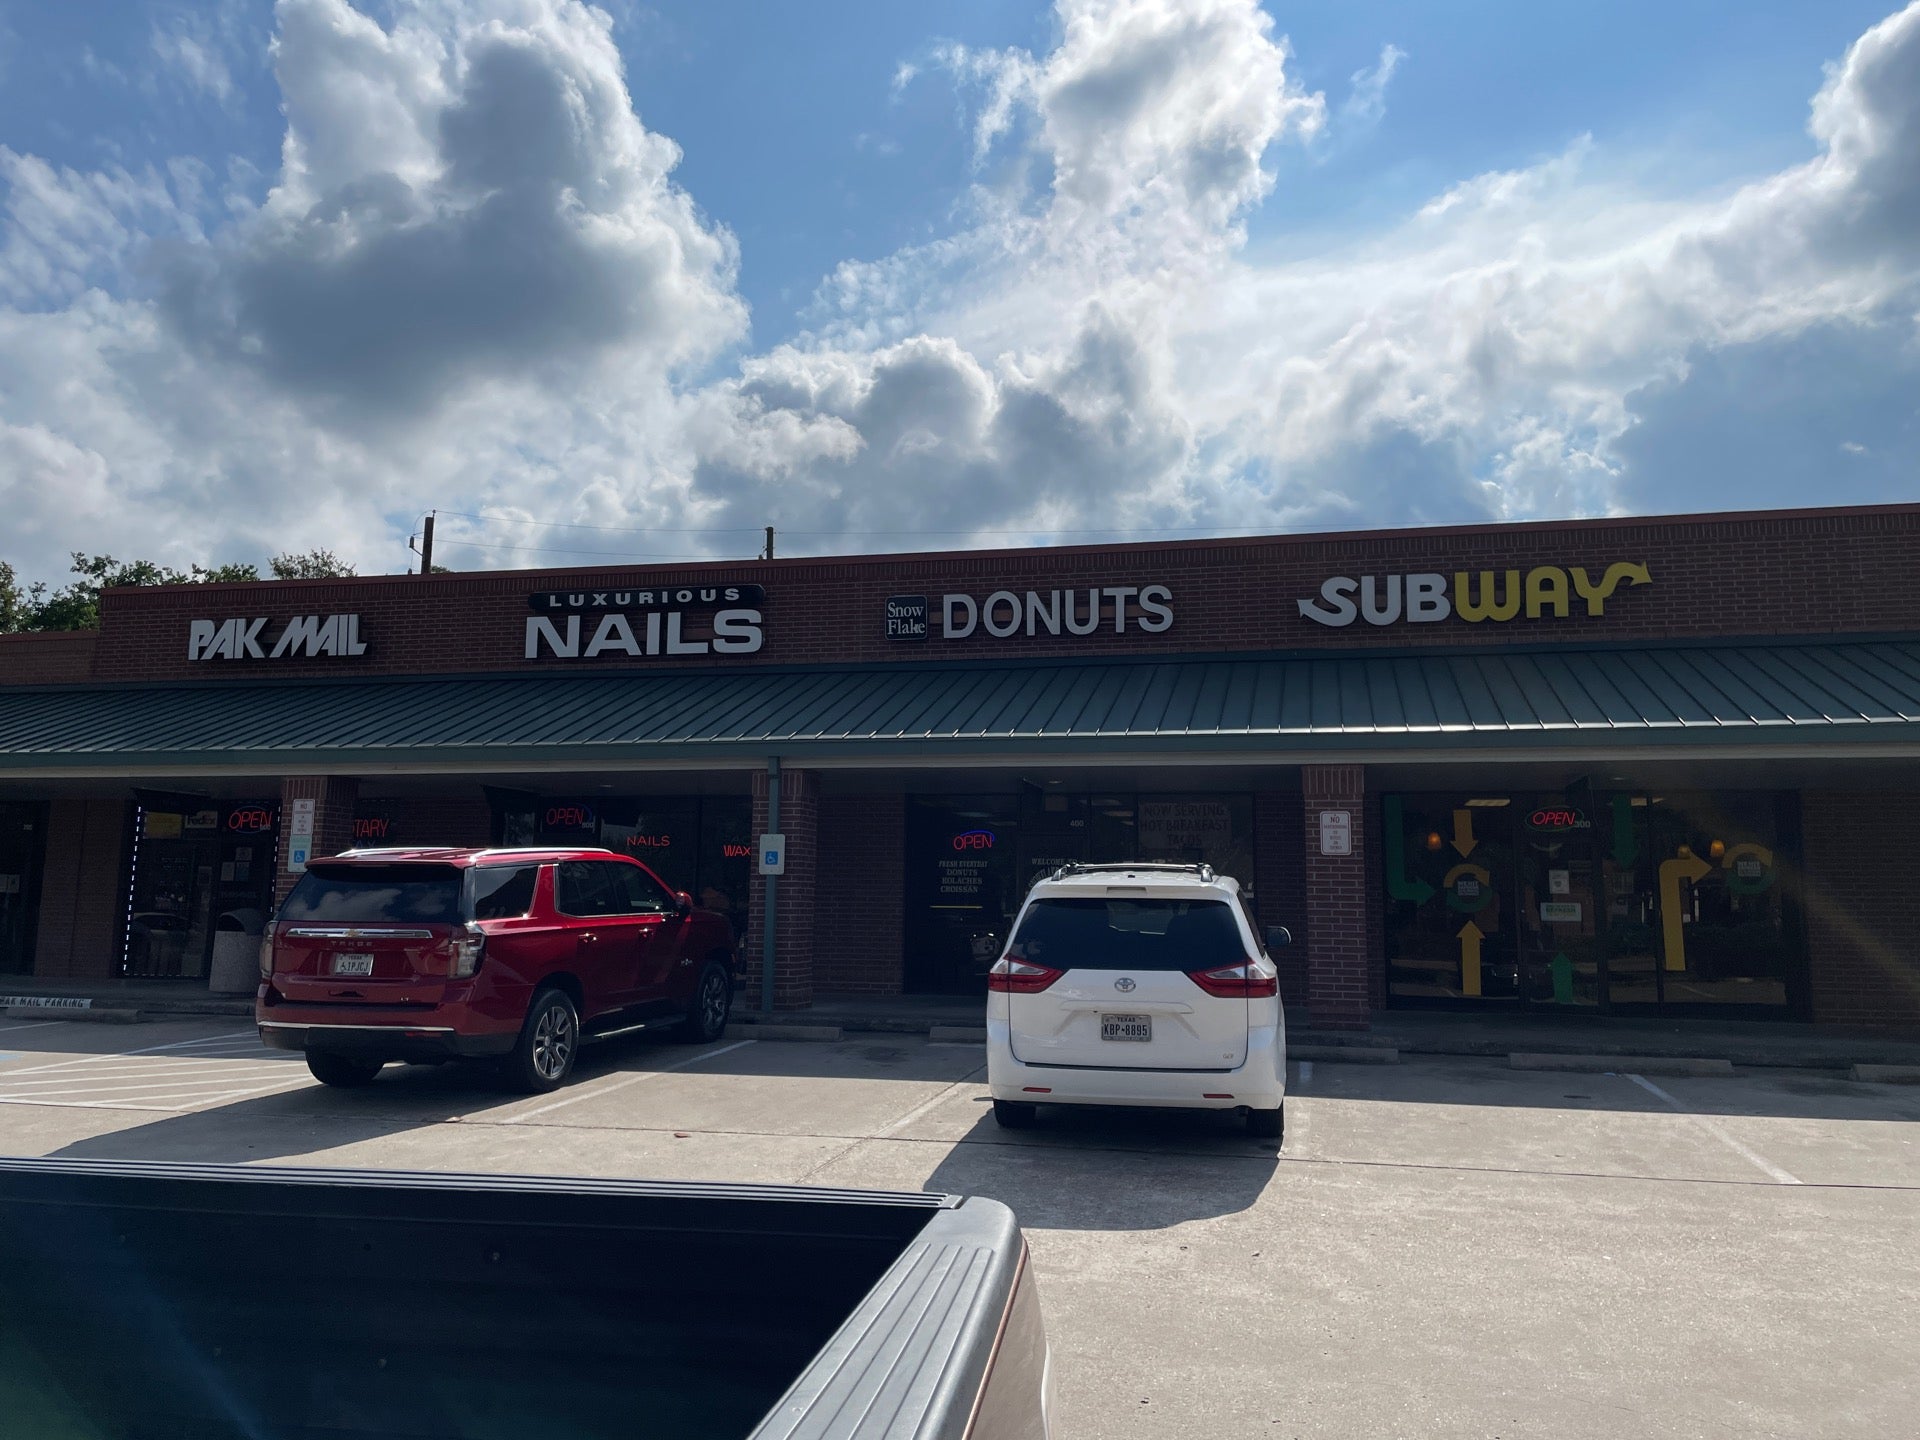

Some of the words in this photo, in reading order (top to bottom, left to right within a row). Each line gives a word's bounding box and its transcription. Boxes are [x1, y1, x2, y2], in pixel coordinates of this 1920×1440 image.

[549, 588, 740, 607] LUXURIOUS
[1296, 561, 1653, 627] SUBWAY
[887, 602, 924, 618] Snow
[943, 585, 1174, 639] DONUTS
[525, 609, 763, 659] NAILS
[887, 619, 926, 635] Flake
[188, 617, 268, 661] PAK
[269, 613, 367, 659] MAIL
[546, 808, 584, 825] OPEN
[1174, 804, 1225, 817] SERVING
[1532, 811, 1576, 825] OPEN
[228, 811, 273, 829] OPEN
[1140, 819, 1164, 832] HOT
[1166, 819, 1229, 832] BREAKFAST
[626, 834, 671, 847] NAILS
[953, 834, 993, 850] OPEN
[723, 844, 752, 857] WAX
[1031, 857, 1065, 865] WELCOME
[946, 868, 978, 876] DONUTS
[19, 998, 41, 1007] MAIL
